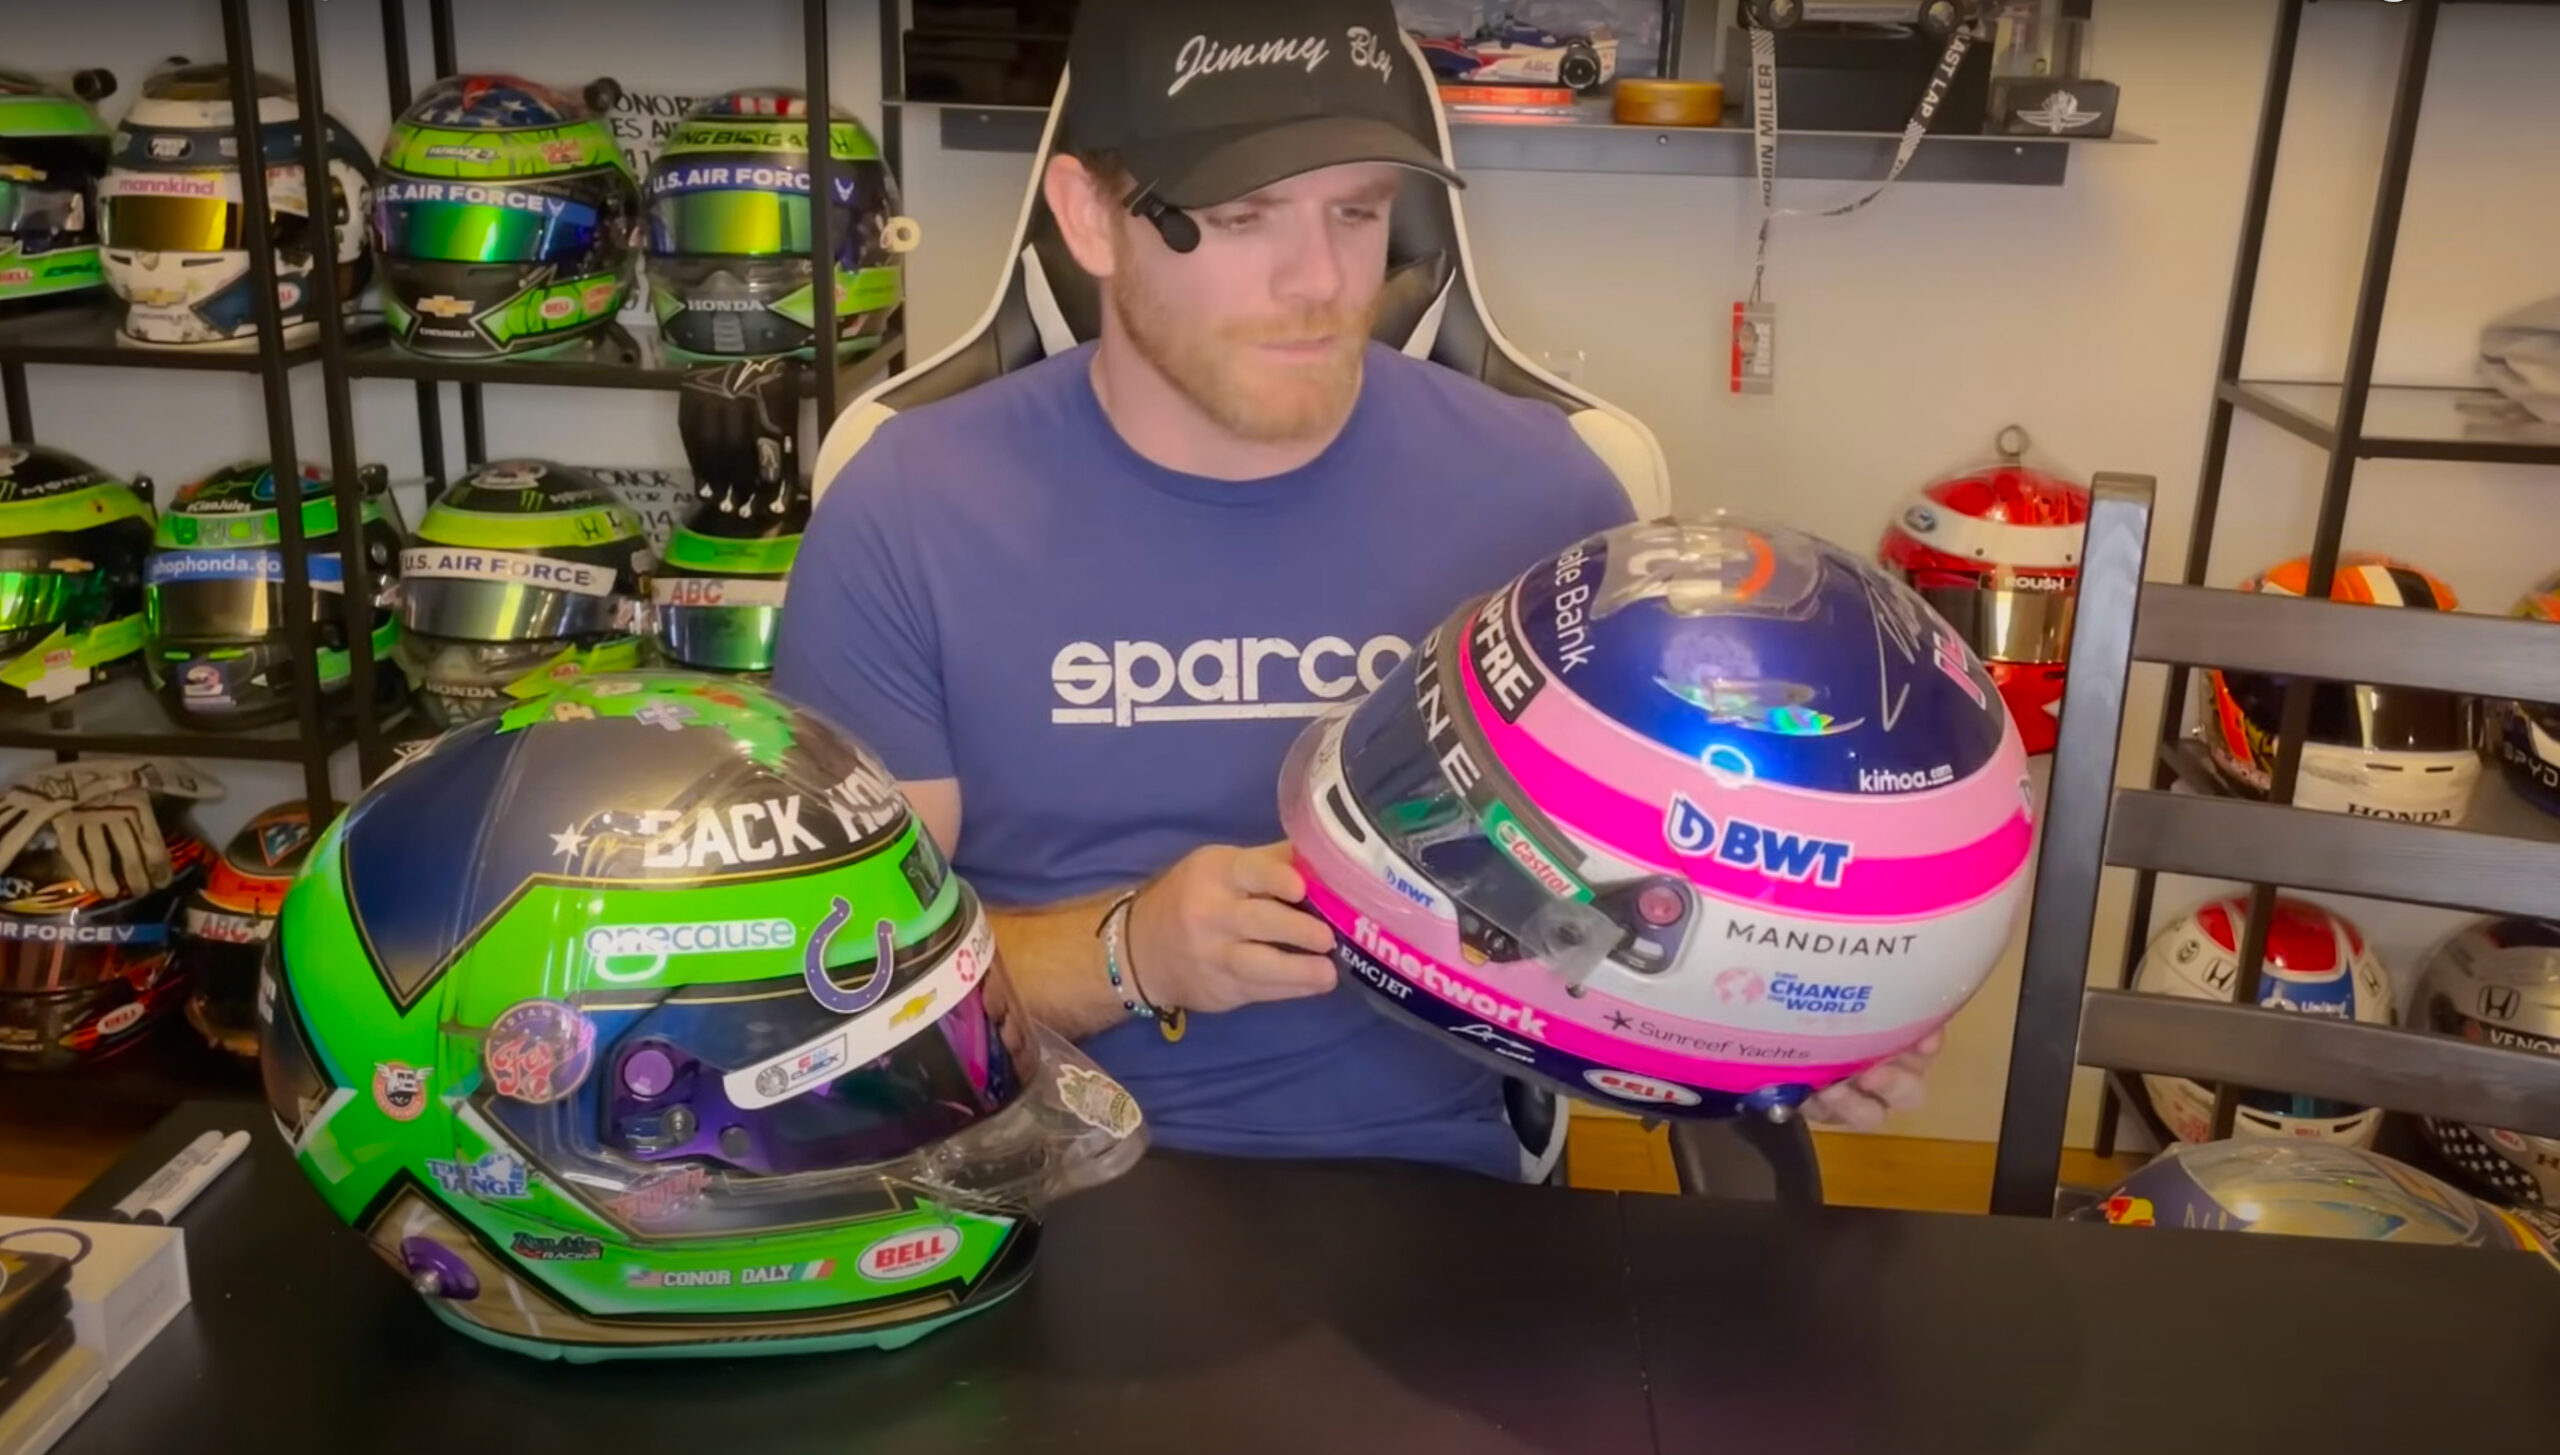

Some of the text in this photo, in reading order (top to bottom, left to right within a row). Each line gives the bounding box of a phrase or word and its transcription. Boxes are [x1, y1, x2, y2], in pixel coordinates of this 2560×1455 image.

[1168, 26, 1393, 96] Jimmy Bly
[1920, 35, 1971, 119] LAST LAP
[615, 93, 694, 117] ONOR
[1758, 64, 1775, 136] MILLER
[610, 117, 643, 139] ES
[118, 176, 216, 196] mannkind
[653, 168, 811, 193] U.S. AIR FORC
[376, 184, 544, 212] U.S. AIR FORCE
[688, 300, 766, 312] HONDA
[404, 554, 592, 586] U.S. AIR FORCE
[2003, 576, 2065, 591] ROUSH
[670, 580, 724, 606] ABC
[1555, 584, 1595, 674] Bank
[426, 682, 498, 699] HONDA
[1051, 634, 1413, 728] sparco
[1859, 763, 1954, 793] kimoa.com
[2502, 748, 2560, 788] SPYD
[2348, 802, 2452, 824] HONDA
[641, 796, 826, 869] BACK
[1719, 819, 1851, 884] BWT
[1510, 838, 1573, 897] Castrol
[1394, 877, 1436, 909] BWT
[23, 923, 113, 942] FORCE
[586, 921, 794, 955] onecause
[1726, 920, 1918, 957] MANDIANT
[1340, 946, 1414, 1001] EMCJET
[1353, 914, 1549, 1041] finetwork
[1770, 980, 1874, 1000] CHANGE
[1786, 998, 1867, 1013] WORLD
[1638, 1020, 1812, 1060] Sunreef Yachts
[2489, 1029, 2560, 1055] VENO
[1601, 1075, 1680, 1102] BELL
[875, 1236, 946, 1270] BELL
[663, 1264, 794, 1287] CONOR DALY
